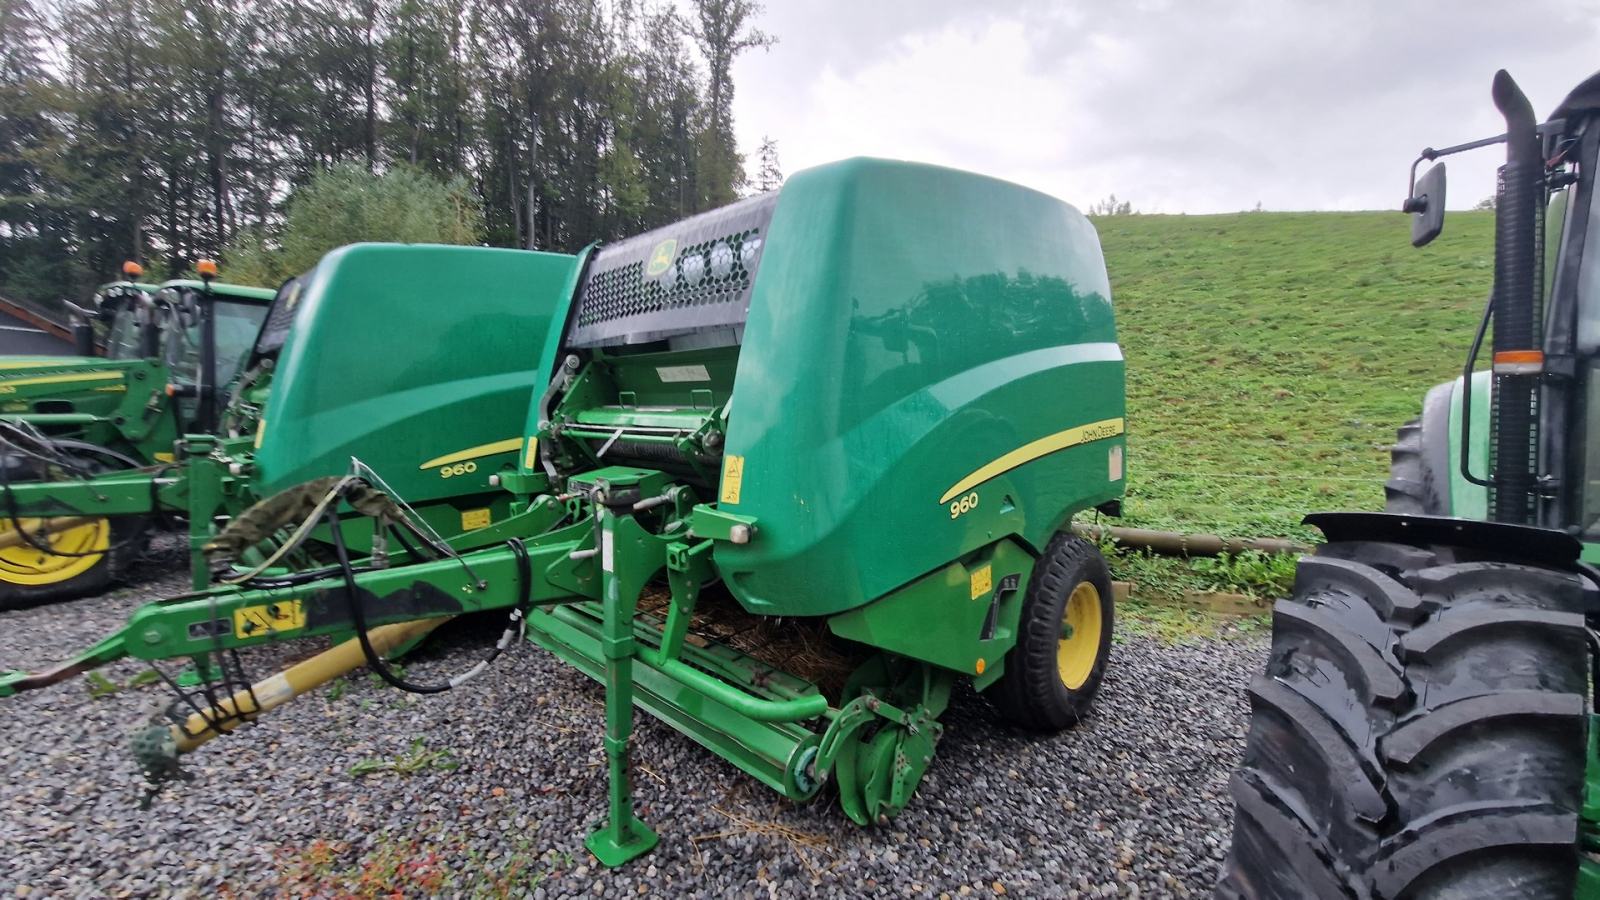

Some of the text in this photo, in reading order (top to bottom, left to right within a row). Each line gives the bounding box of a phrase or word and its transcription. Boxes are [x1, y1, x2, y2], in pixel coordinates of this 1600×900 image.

[1098, 425, 1116, 437] DEERE
[440, 461, 477, 479] 960
[950, 492, 979, 519] 960
